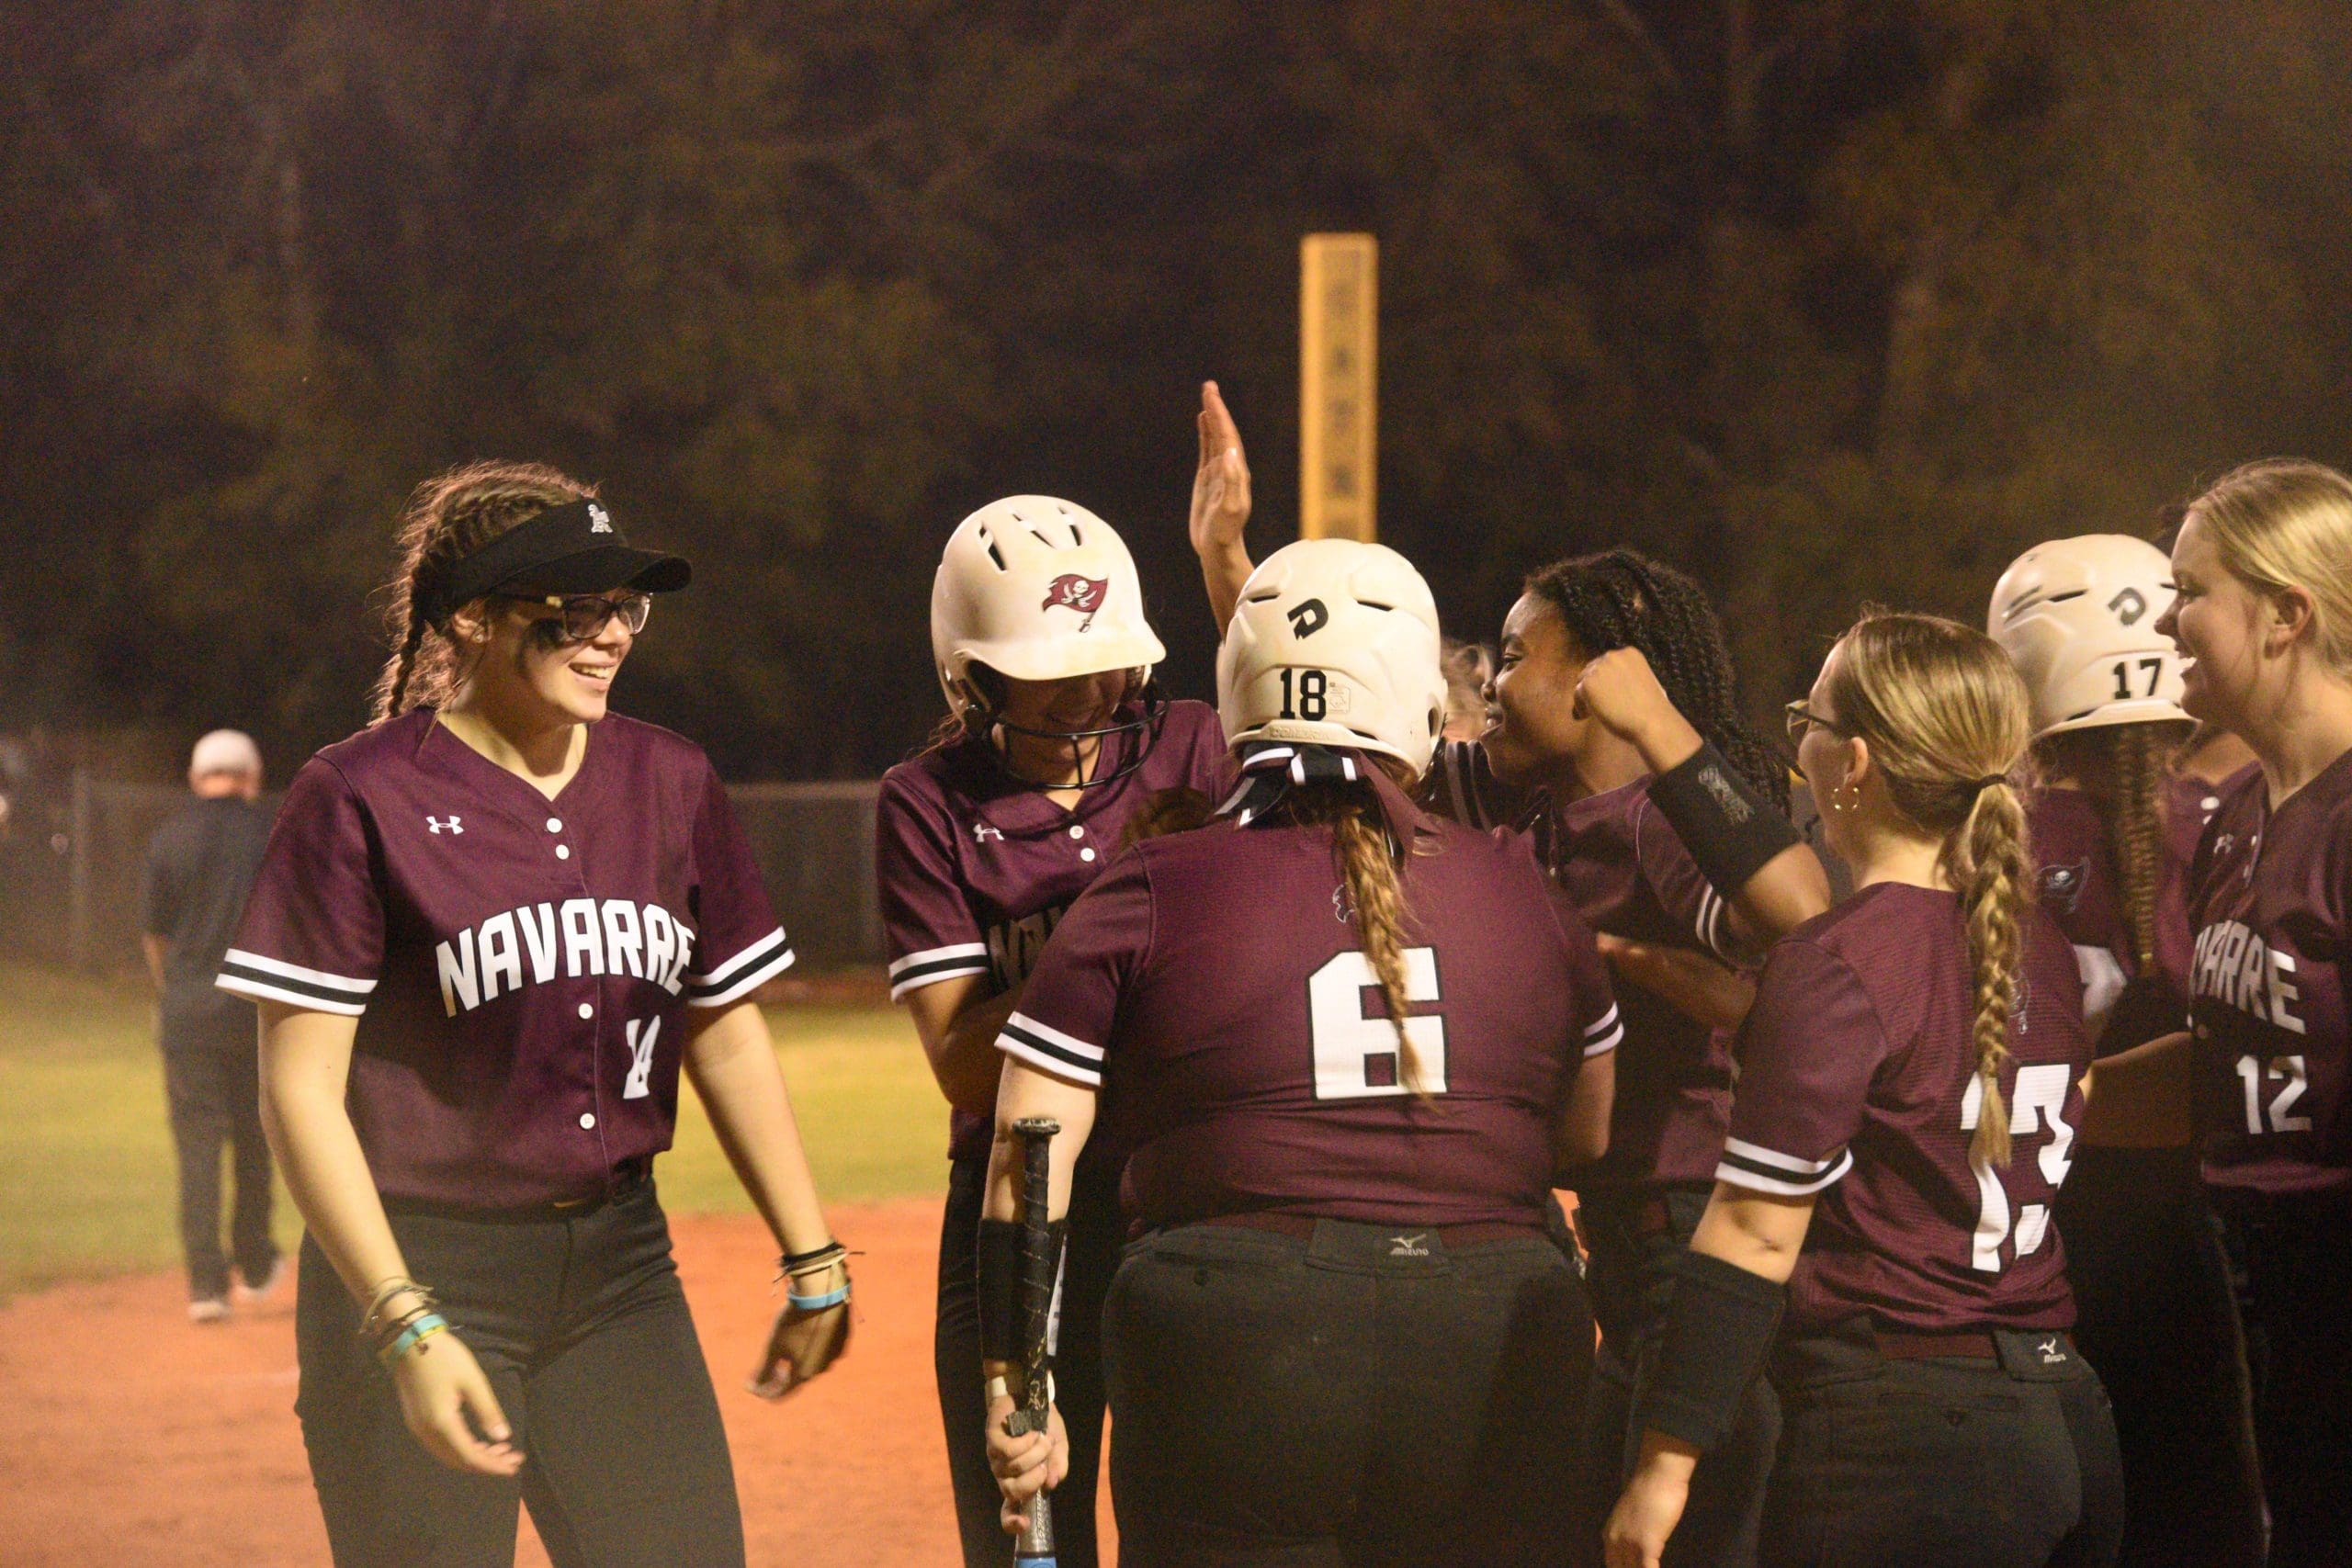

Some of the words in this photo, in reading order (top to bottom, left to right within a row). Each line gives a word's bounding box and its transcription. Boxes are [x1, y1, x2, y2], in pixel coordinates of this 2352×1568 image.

[1280, 668, 1327, 721] 18
[2113, 658, 2162, 700] 17
[435, 897, 695, 1018] NAVARRE
[1308, 946, 1448, 1100] 6
[2236, 1055, 2312, 1134] 12
